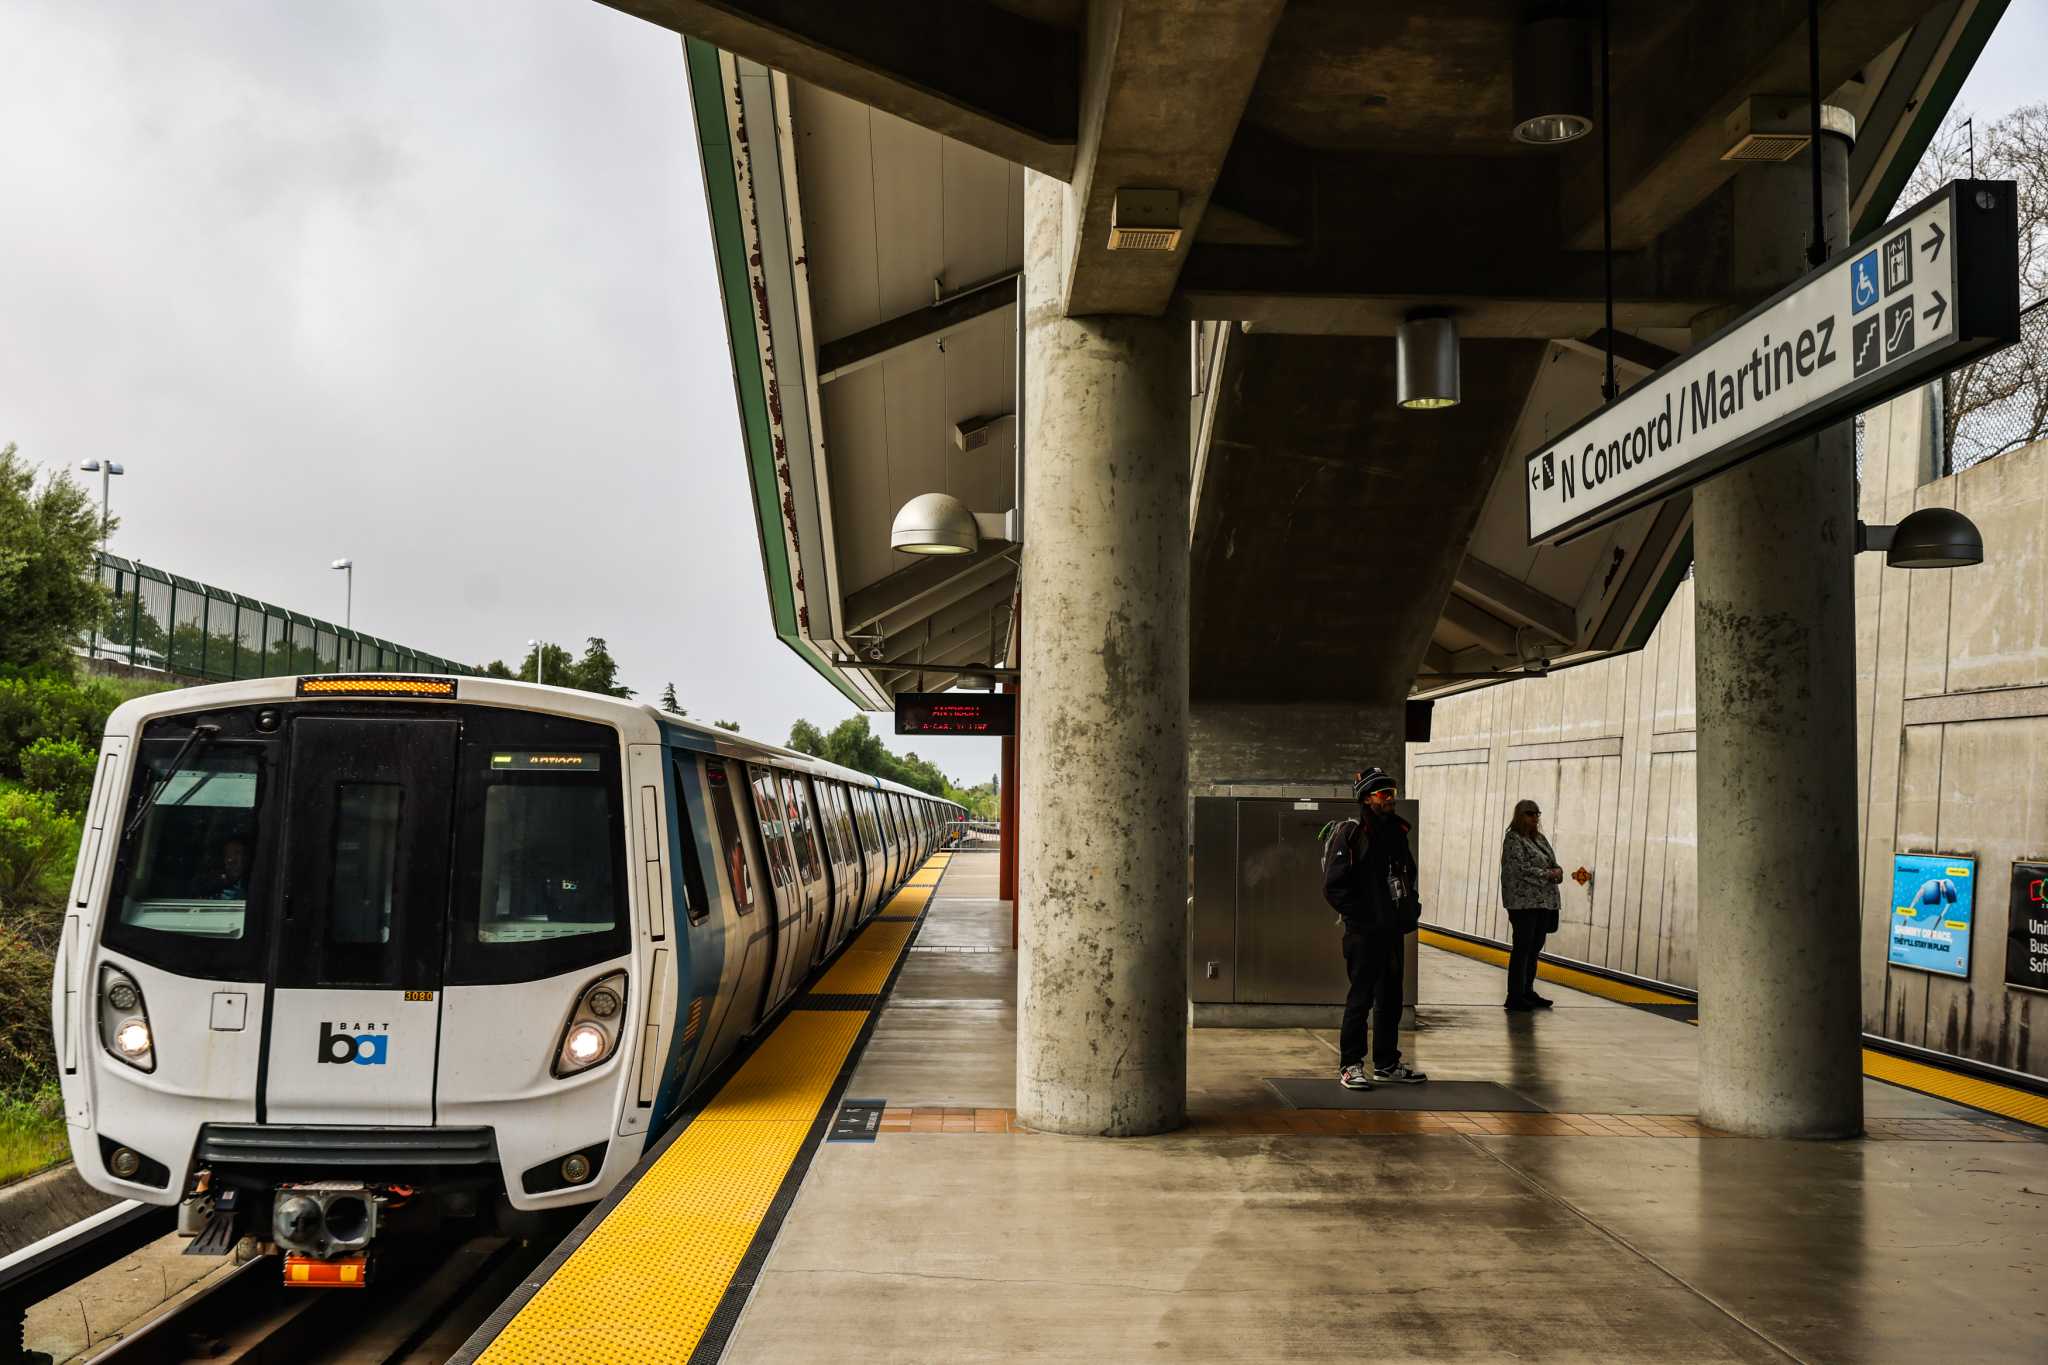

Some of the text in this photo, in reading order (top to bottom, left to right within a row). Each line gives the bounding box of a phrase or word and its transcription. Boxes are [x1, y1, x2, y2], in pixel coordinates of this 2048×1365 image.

[1561, 454, 1575, 503] N
[405, 991, 433, 1001] 3080
[340, 1023, 389, 1031] BART
